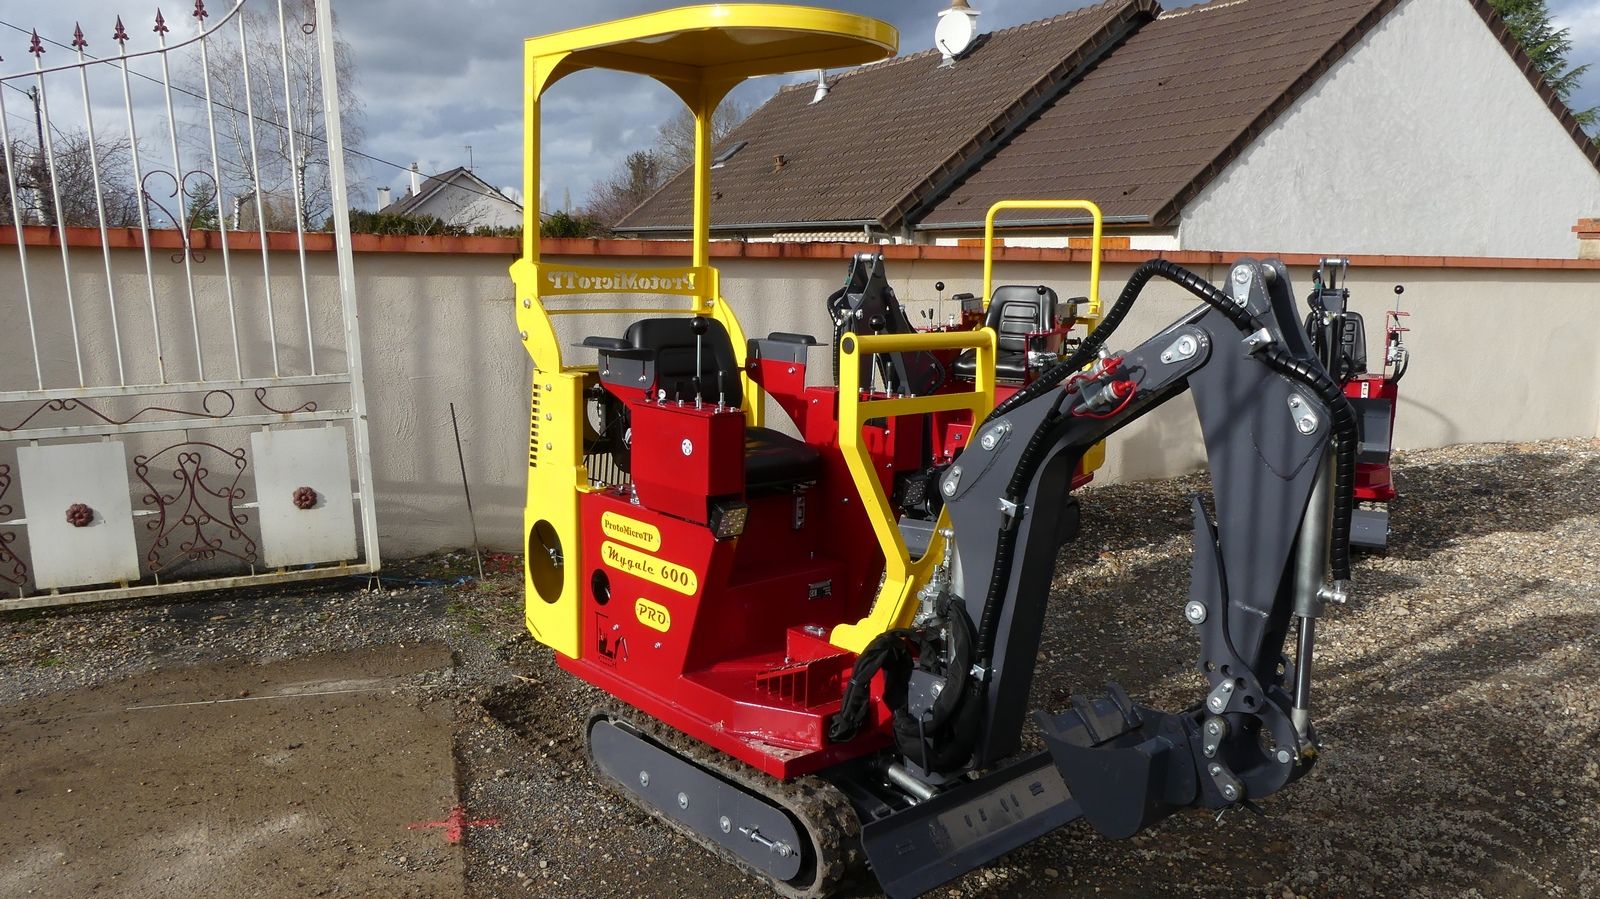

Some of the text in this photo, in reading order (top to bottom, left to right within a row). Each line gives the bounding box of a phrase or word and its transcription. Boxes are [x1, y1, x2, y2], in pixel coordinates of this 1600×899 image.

[604, 519, 653, 542] ProtoMicroTP
[608, 546, 688, 586] Mygale 600
[639, 603, 666, 625] PRO
